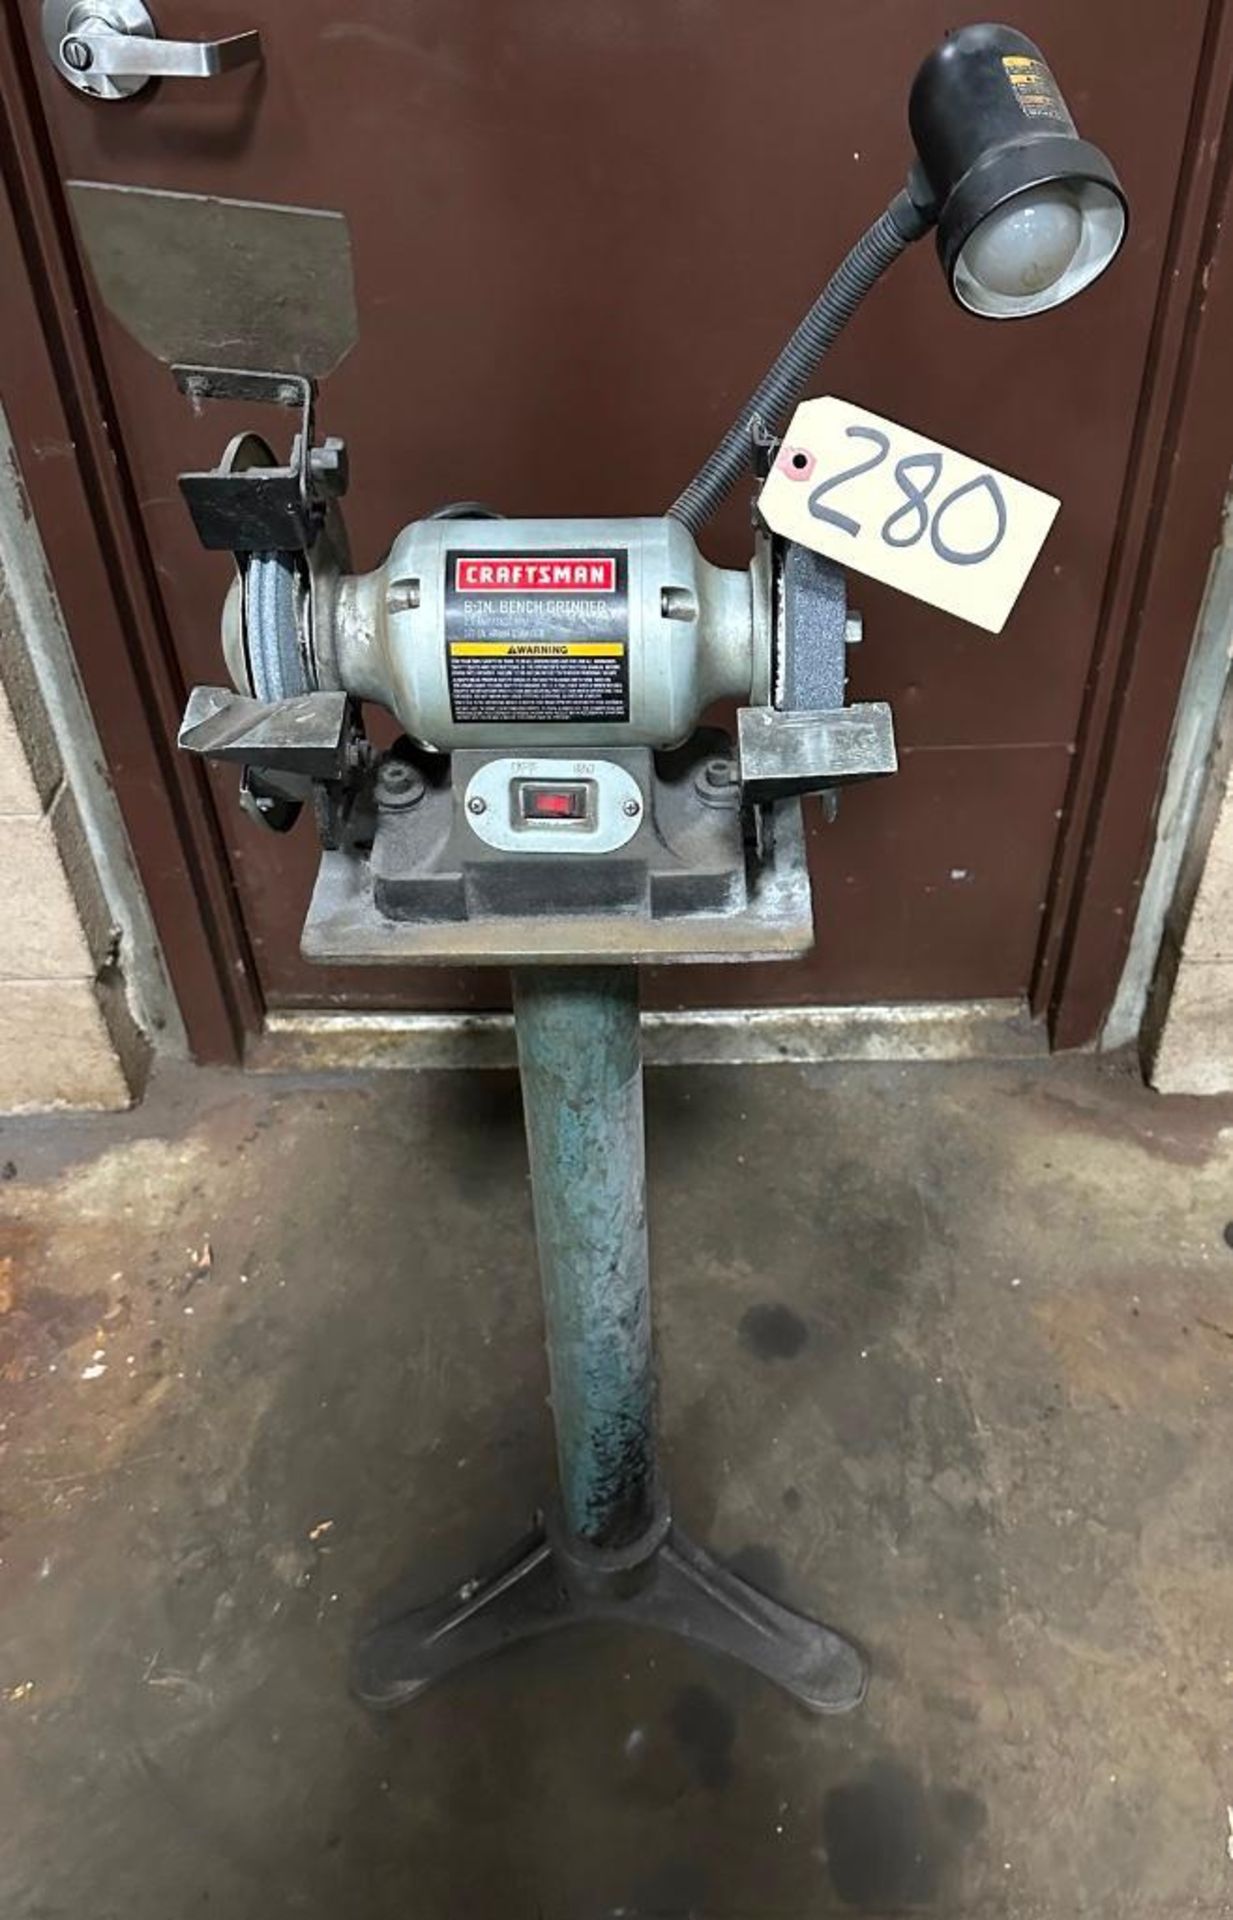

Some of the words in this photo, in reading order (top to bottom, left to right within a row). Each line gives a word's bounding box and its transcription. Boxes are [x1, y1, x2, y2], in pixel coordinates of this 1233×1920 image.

[808, 426, 1007, 565] 280
[465, 565, 605, 584] CRAFTSMAN
[499, 600, 543, 615] BENCH
[546, 600, 607, 615] GRINDER
[517, 645, 569, 655] WARNING
